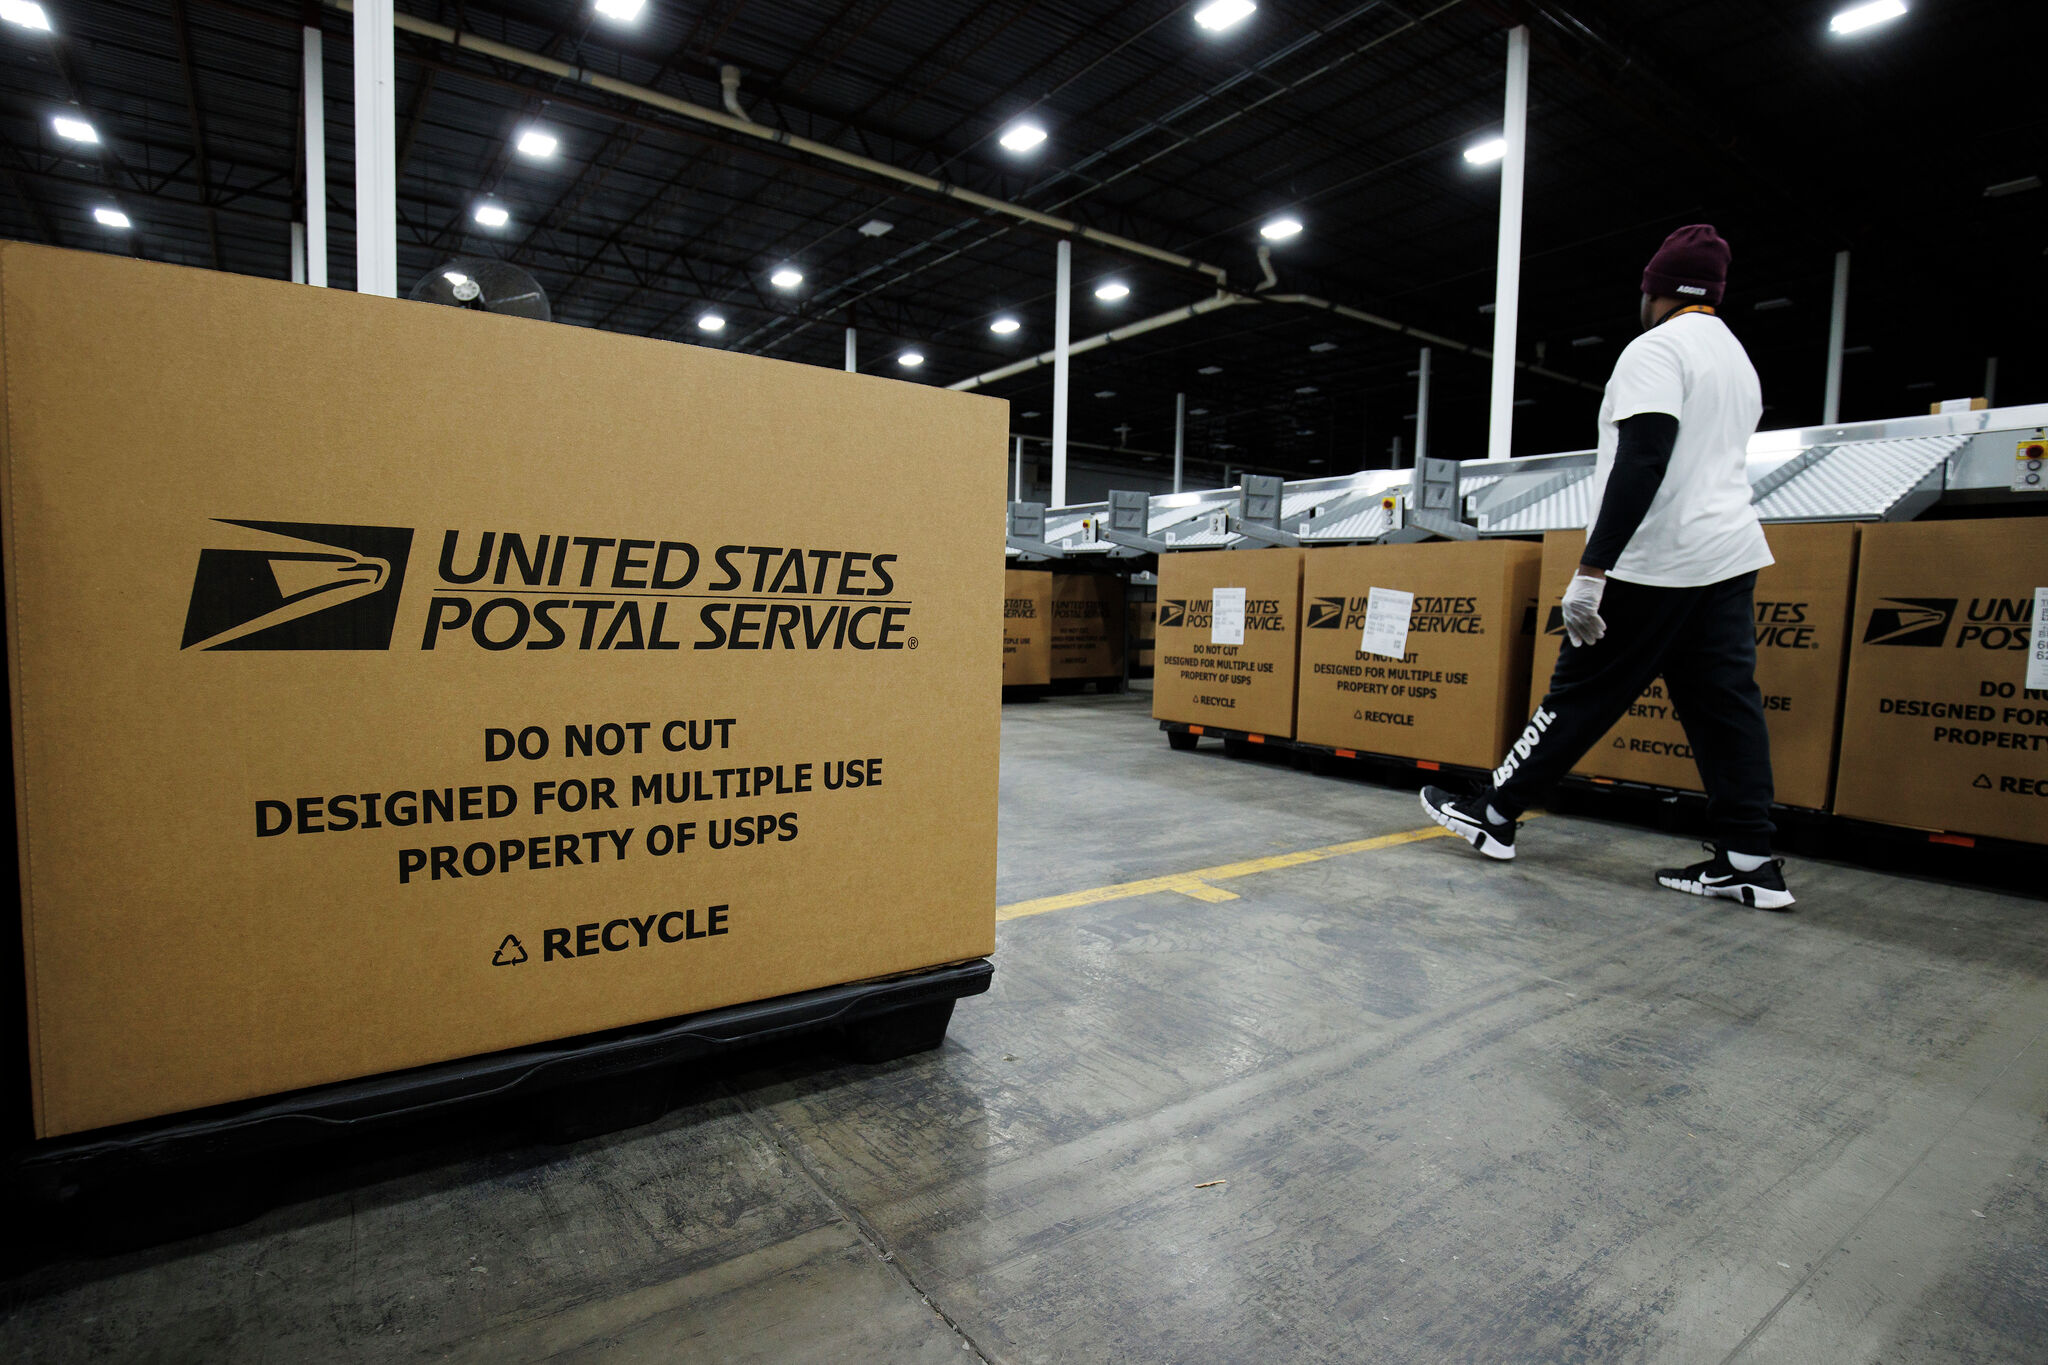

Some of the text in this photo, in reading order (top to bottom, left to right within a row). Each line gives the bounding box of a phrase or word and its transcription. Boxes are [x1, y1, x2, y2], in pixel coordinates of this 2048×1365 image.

[436, 530, 898, 596] UNITED STATES
[1189, 600, 1279, 614] UNIT TATES
[1412, 597, 1477, 613] STATES
[1756, 602, 1808, 623] TES
[1967, 598, 2034, 623] UNI
[420, 597, 681, 650] POSTAL
[1186, 615, 1282, 631] POST RVICE
[1754, 627, 1815, 649] VICE
[1956, 626, 2031, 650] POS
[1193, 645, 1239, 656] DO NOT CUT
[1355, 650, 1370, 661] DO
[1164, 656, 1274, 673] DESIGNED FOR MULTIPLE USE
[1314, 663, 1468, 684] DESIGNED FOR MULTIPLE USE
[1180, 671, 1252, 685] PROPERTY OF USPS
[1337, 680, 1437, 699] PROPERTY OF USPS
[1979, 681, 2016, 698] DO
[1200, 695, 1236, 708] RECYCLE
[1628, 704, 1668, 719] ERTY
[1763, 696, 1792, 711] SE
[1365, 711, 1414, 726] RECYCLE
[1879, 699, 2048, 727] DESIGNED FOR
[485, 719, 736, 761] DO NOT CUT
[1513, 725, 1540, 760] DO
[1630, 738, 1695, 758] RECYCL
[255, 758, 883, 838] DESIGNED FOR MULTIPLE USE
[400, 812, 799, 884] PROPERTY OF USPS
[544, 905, 729, 961] RECYCLE
